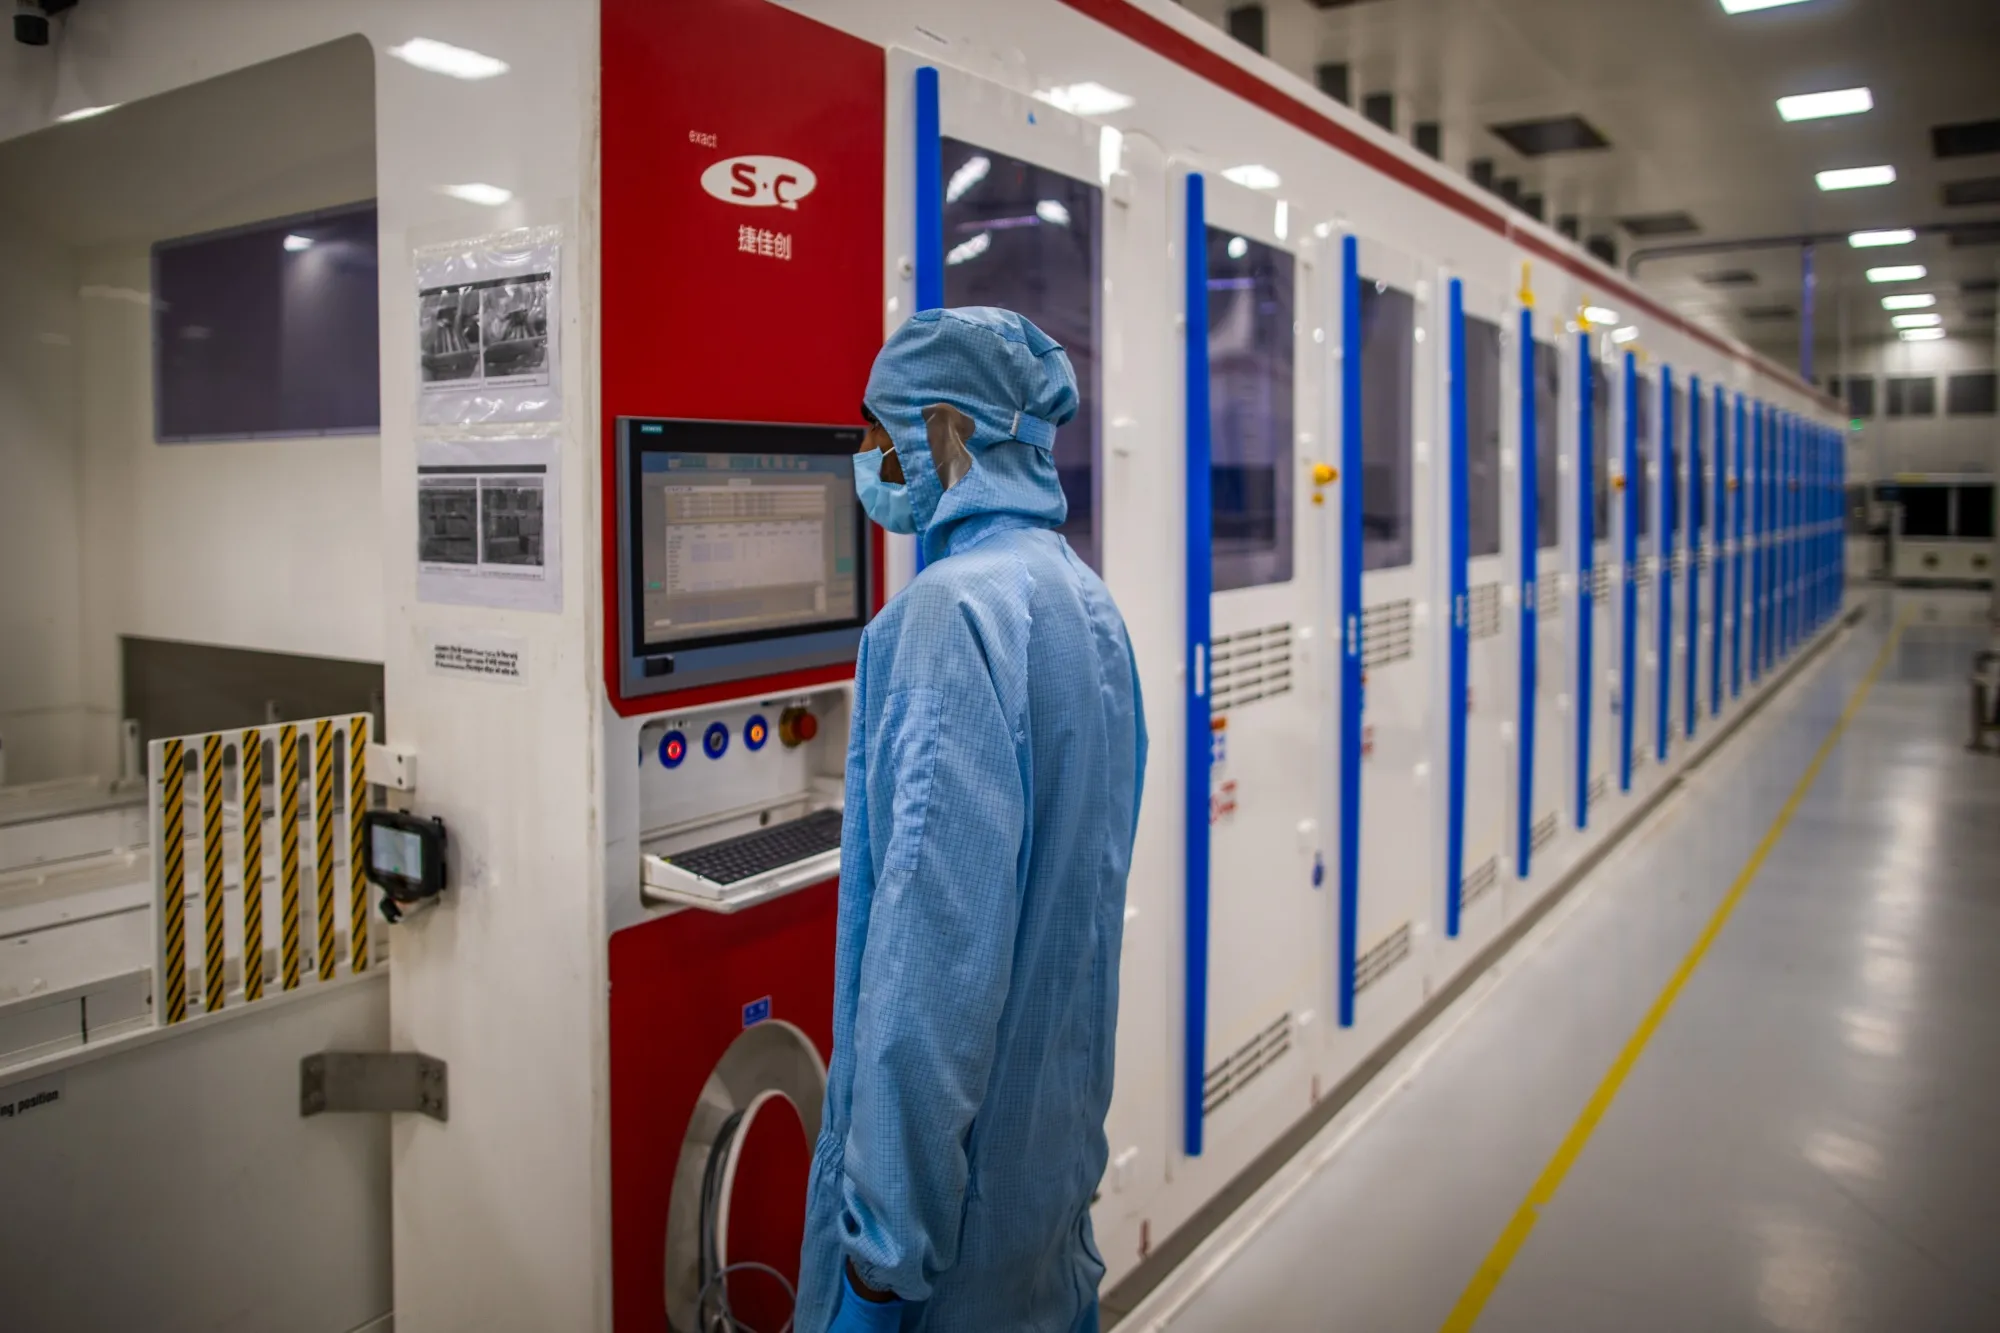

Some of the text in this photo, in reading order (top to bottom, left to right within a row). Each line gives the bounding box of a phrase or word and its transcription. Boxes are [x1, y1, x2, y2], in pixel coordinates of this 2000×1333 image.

[689, 130, 717, 148] exact
[738, 224, 793, 261] 捷佳创
[0, 1090, 59, 1117] ng position
